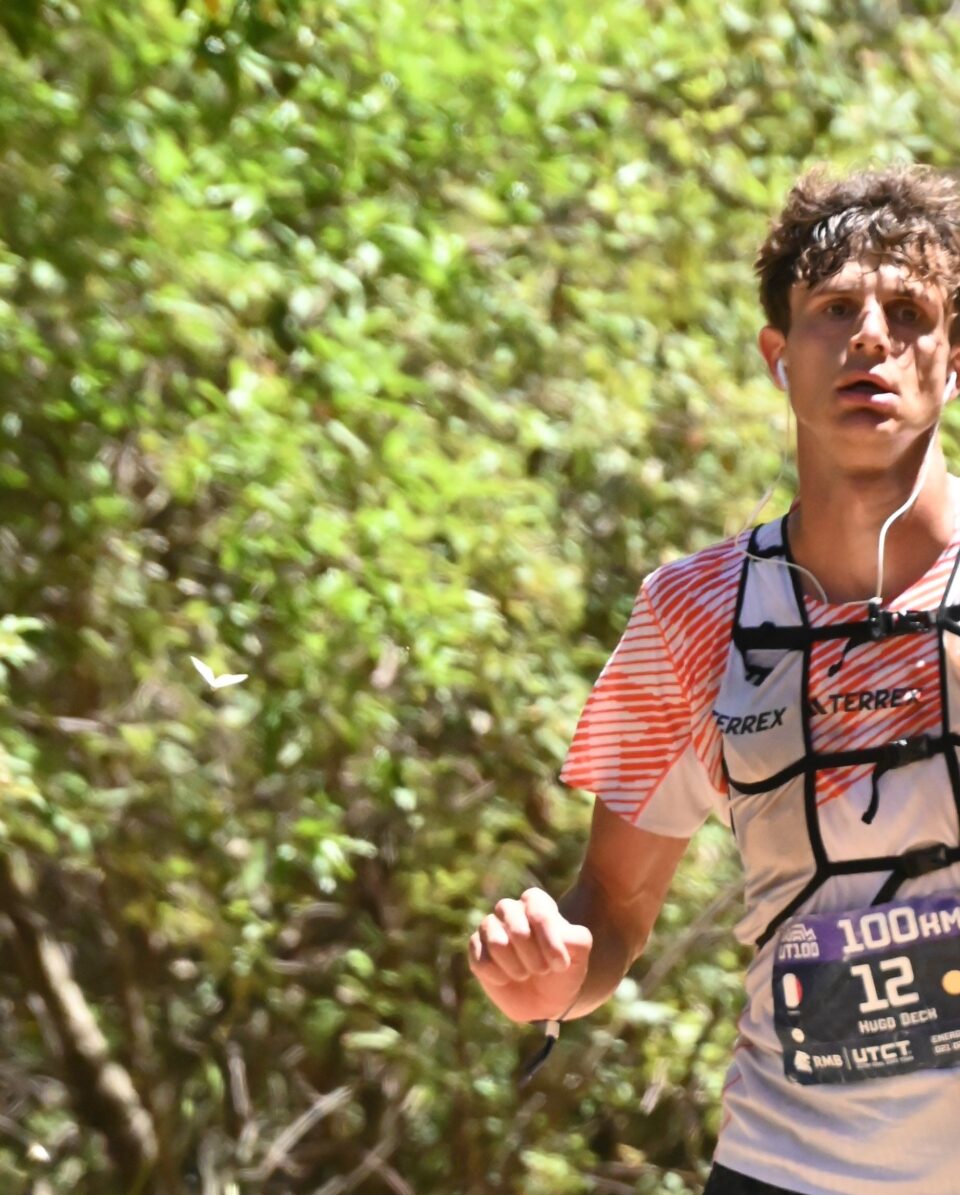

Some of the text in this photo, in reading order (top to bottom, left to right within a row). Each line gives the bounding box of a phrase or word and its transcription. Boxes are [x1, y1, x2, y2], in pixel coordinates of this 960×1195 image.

[850, 956, 920, 1013] 12
[858, 1016, 896, 1034] HUGO
[812, 1054, 843, 1069] RMB
[852, 1040, 911, 1063] UTCT
